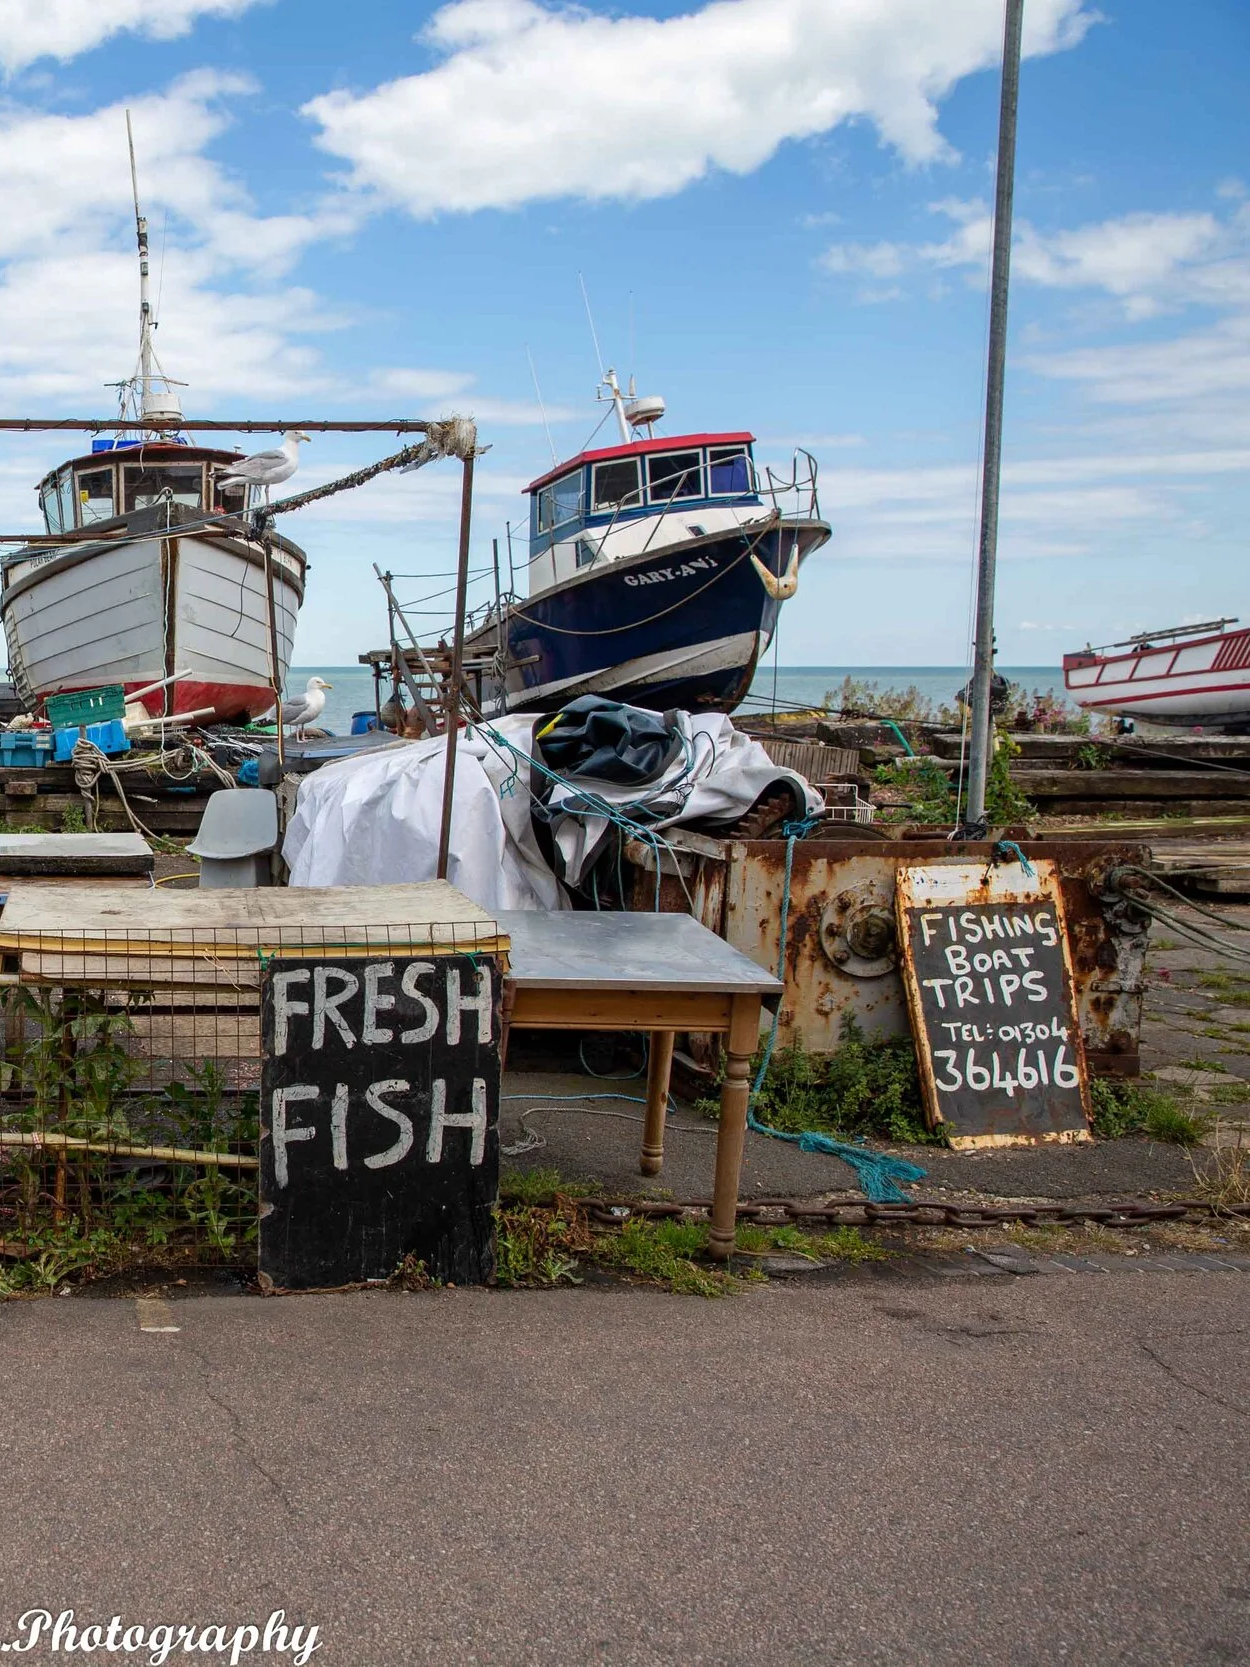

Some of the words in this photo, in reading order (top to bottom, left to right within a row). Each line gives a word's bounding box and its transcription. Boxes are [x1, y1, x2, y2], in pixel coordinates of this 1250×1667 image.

[920, 911, 1058, 947] FISHING
[944, 944, 1035, 976] BOAT
[272, 961, 493, 1057] FRESH
[922, 970, 1048, 1009] TRIPS
[998, 1016, 1068, 1044] 01304
[934, 1044, 1080, 1097] 364616
[272, 1077, 488, 1190] FISH
